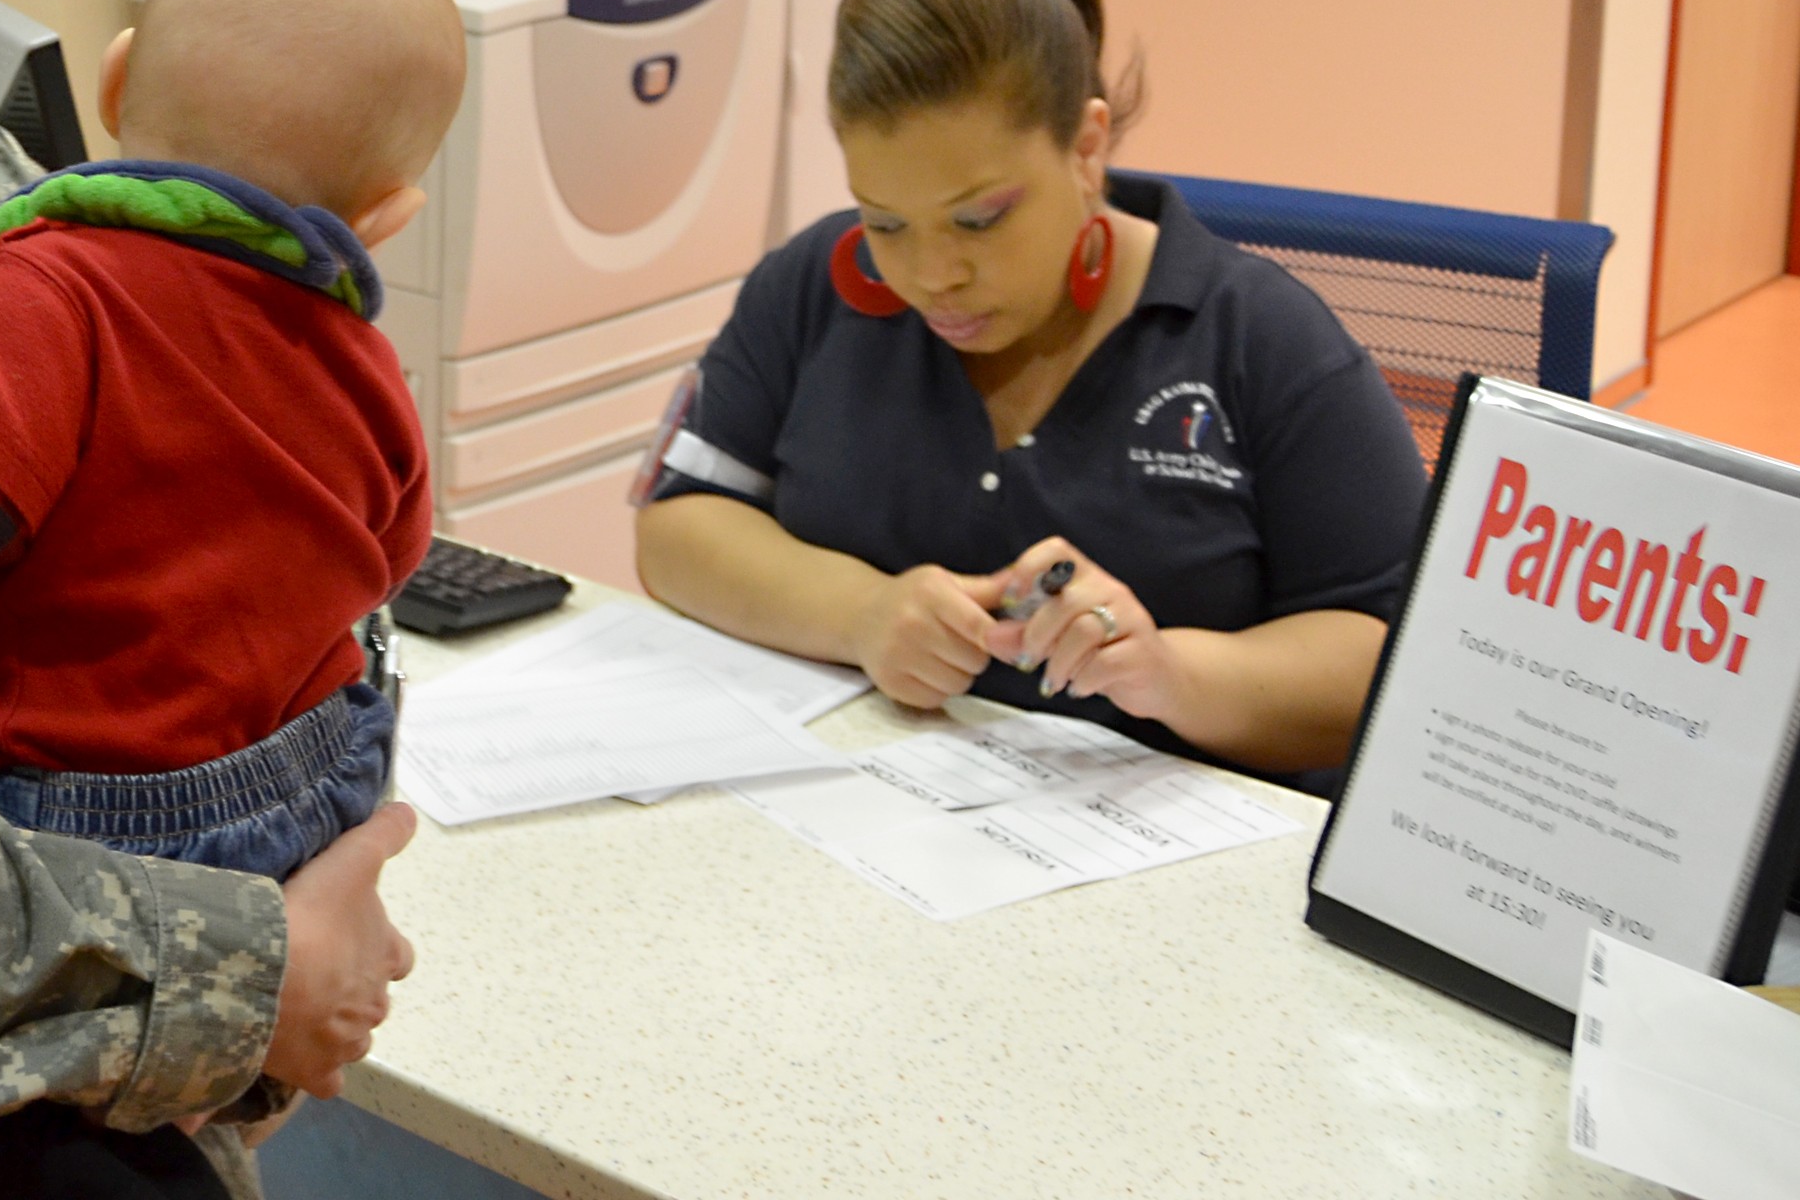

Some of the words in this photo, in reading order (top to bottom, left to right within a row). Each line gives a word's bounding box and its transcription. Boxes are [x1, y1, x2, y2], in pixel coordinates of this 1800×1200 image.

[1464, 456, 1768, 675] Parents:
[1458, 628, 1508, 667] Today
[1511, 649, 1525, 669] is
[1528, 659, 1560, 680] our
[1561, 669, 1619, 704] Grand
[1620, 691, 1710, 740] Opening!
[974, 739, 1050, 781] VISITOR
[858, 762, 941, 805] VISITOR
[1086, 802, 1170, 847] VISITOR
[974, 826, 1057, 871] VISITOR
[1391, 809, 1420, 836] We
[1420, 822, 1457, 854] look
[1460, 840, 1531, 885] forward
[1533, 873, 1553, 896] to
[1554, 886, 1616, 929] seeing
[1616, 913, 1656, 941] you
[1465, 883, 1486, 904] at
[1488, 890, 1548, 931] 15:30!
